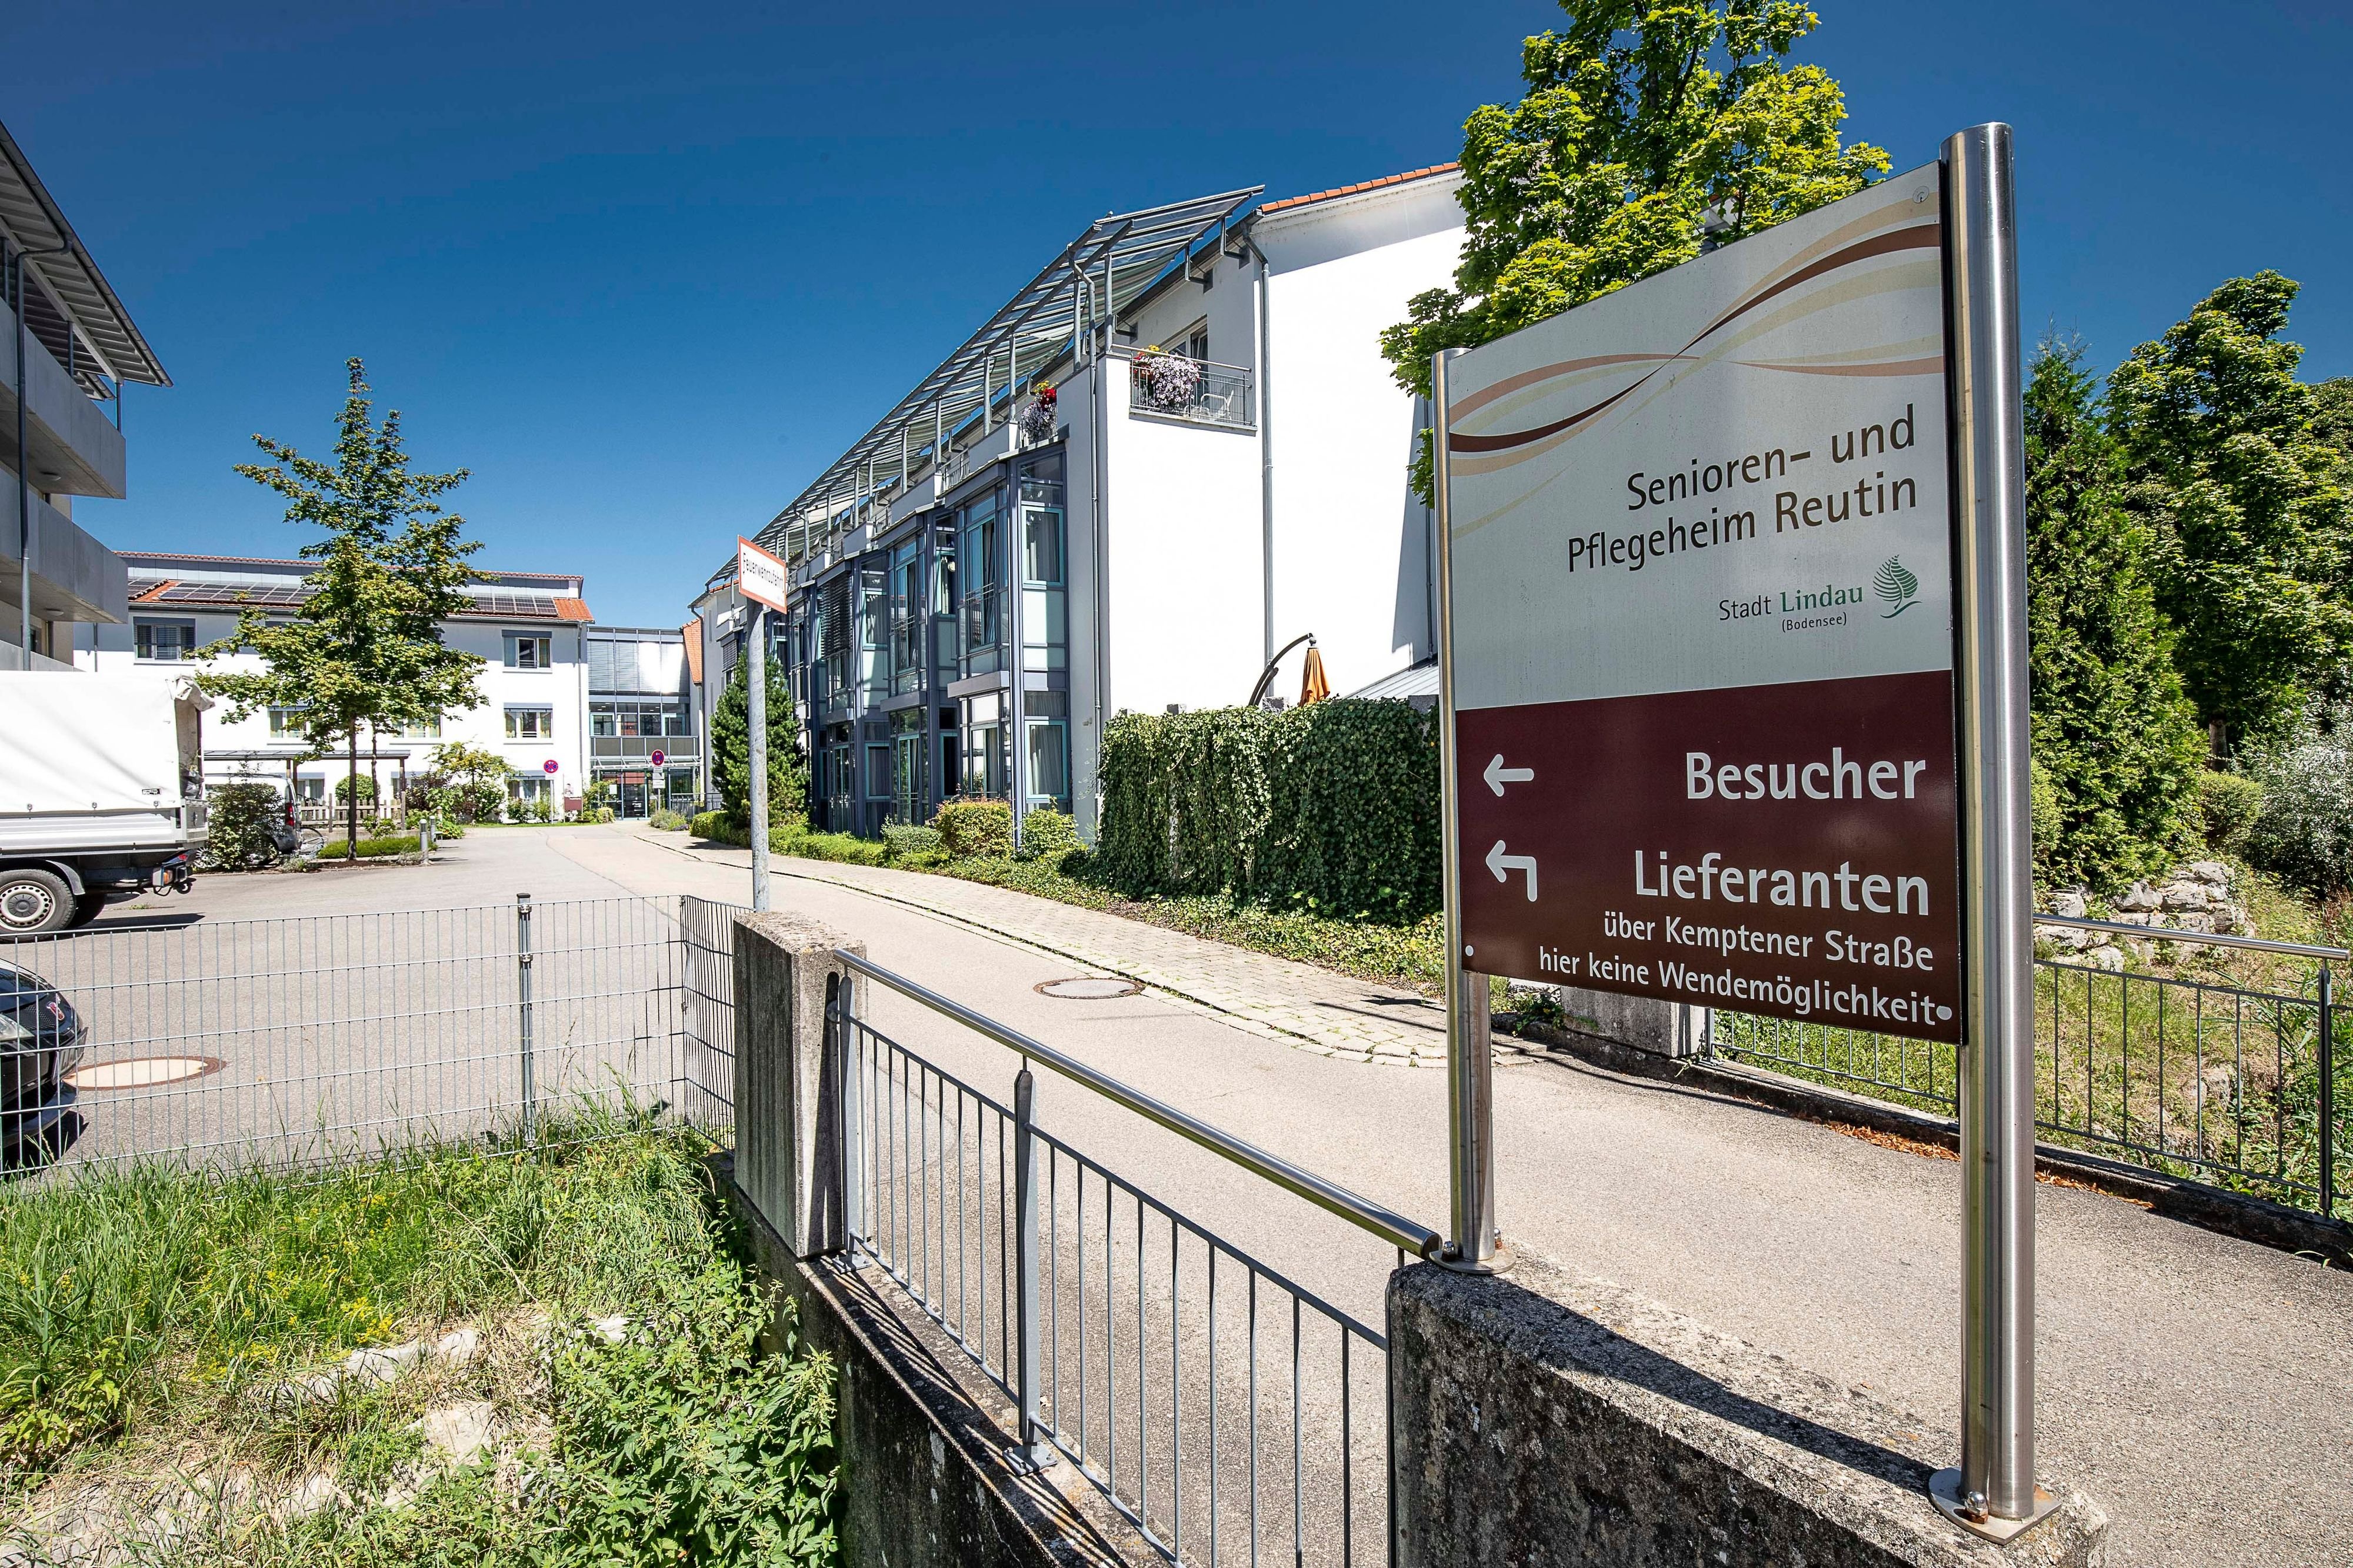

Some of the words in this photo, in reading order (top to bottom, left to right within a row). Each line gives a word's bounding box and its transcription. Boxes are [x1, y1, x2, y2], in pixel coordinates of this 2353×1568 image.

[1628, 448, 1810, 510] Senioren-
[1831, 403, 1914, 463] und
[1568, 508, 1755, 572] Pflegeheim
[1775, 472, 1916, 533] Reutin
[743, 552, 783, 589] Feuerwehrzufahrt
[1719, 595, 1771, 620] Stadt
[1780, 585, 1863, 612] Lindau
[1782, 612, 1847, 633] (Bodensee)
[1687, 747, 1925, 799] Besucher
[1635, 850, 1928, 915] Lieferanten
[1604, 911, 1655, 940] über
[1666, 916, 1812, 957] Kemptener
[1825, 930, 1933, 971] Straße
[1539, 946, 1580, 974] hier
[1589, 953, 1649, 985] keine
[1658, 961, 1935, 1025] Wendemöglichkeit
